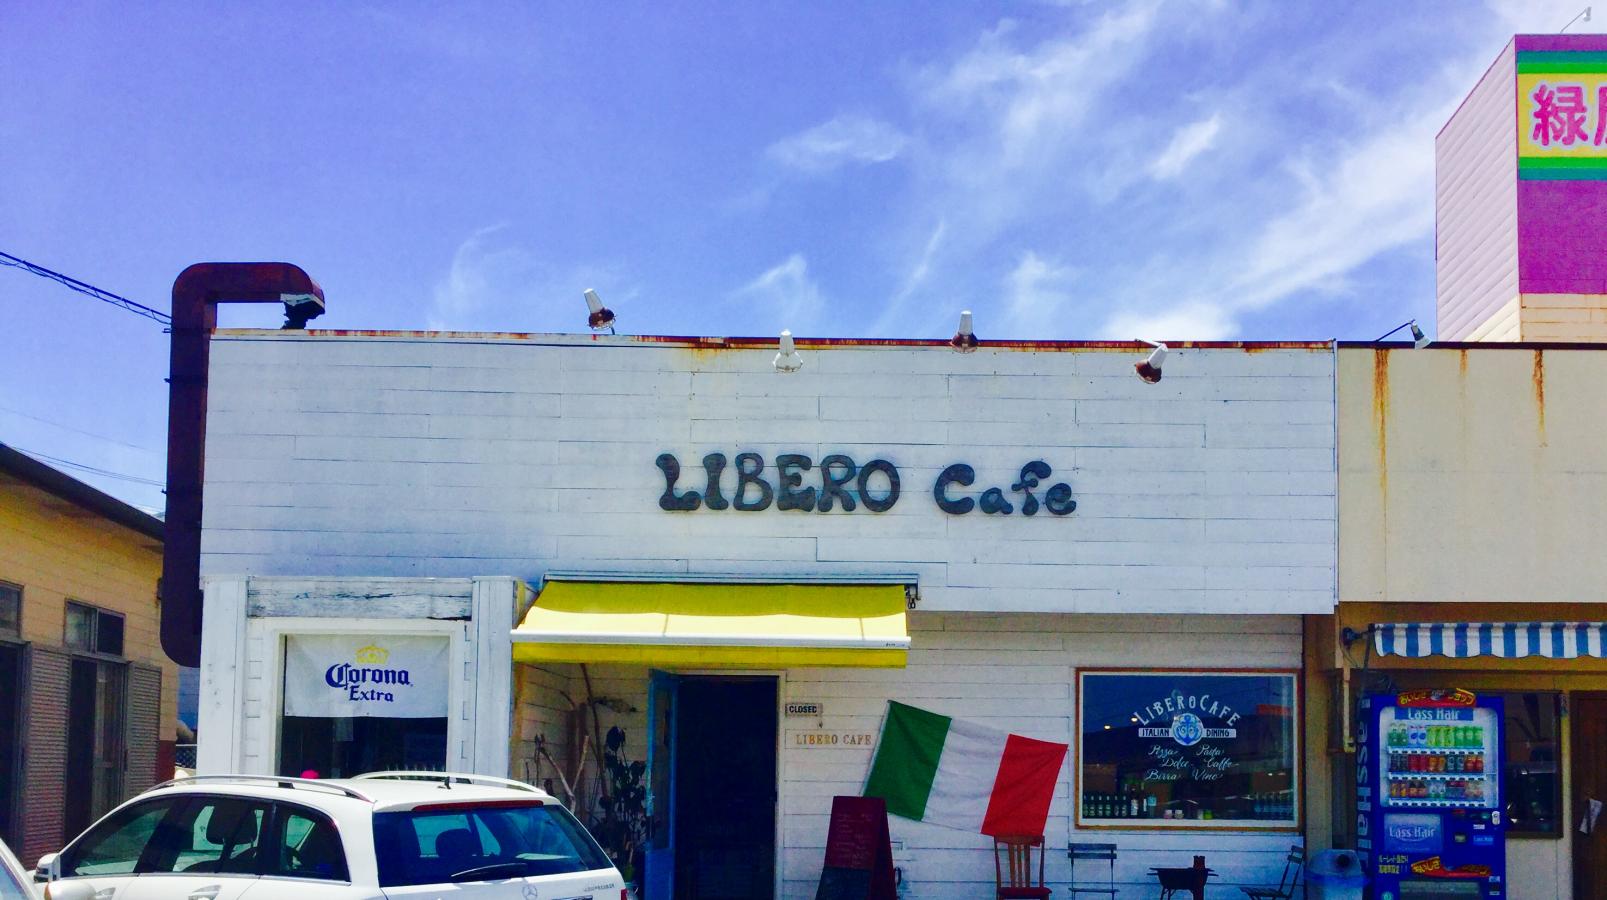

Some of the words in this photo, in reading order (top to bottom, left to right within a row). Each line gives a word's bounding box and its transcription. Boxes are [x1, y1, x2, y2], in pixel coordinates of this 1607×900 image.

[1533, 84, 1607, 146] 緑
[655, 452, 901, 513] LIBERO
[934, 460, 1077, 516] Cafe
[325, 663, 410, 690] Corona
[349, 685, 394, 702] Extra
[789, 705, 818, 714] CLOSED
[1407, 707, 1433, 720] Lass
[1436, 707, 1460, 720] Hair
[796, 734, 838, 745] LIBERO
[843, 734, 872, 746] CAFE
[1142, 728, 1170, 737] ITALIAN
[1206, 729, 1230, 737] DINING
